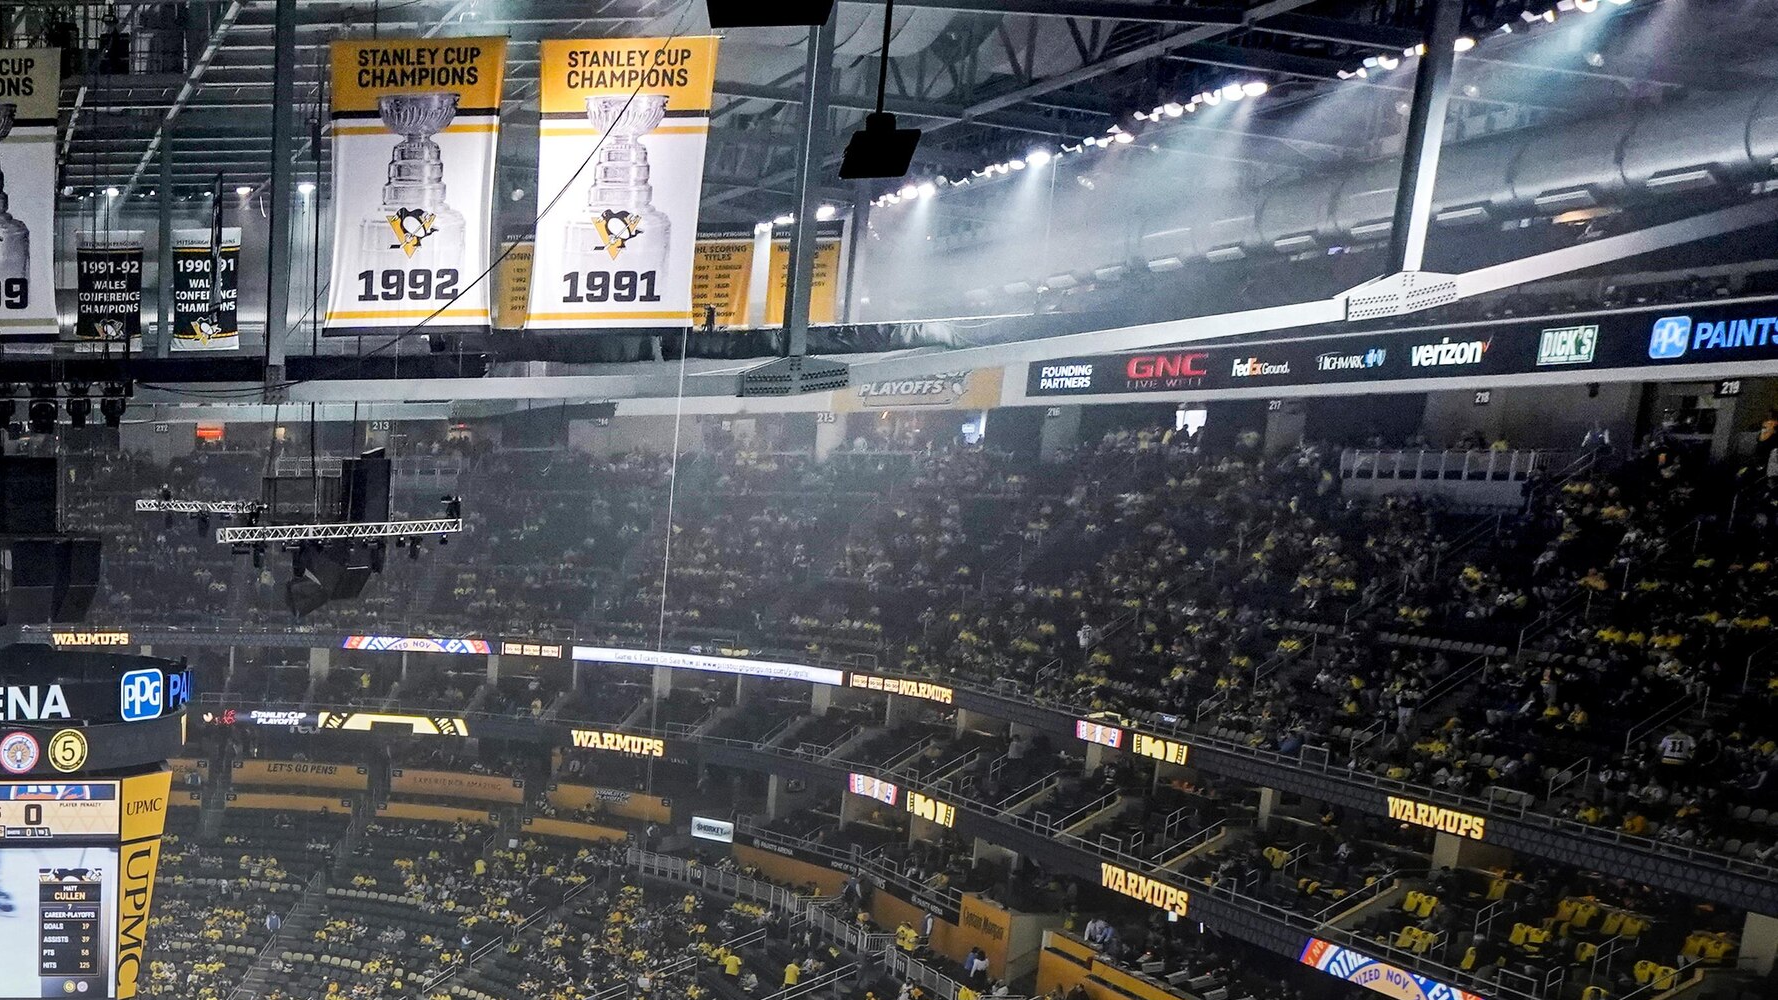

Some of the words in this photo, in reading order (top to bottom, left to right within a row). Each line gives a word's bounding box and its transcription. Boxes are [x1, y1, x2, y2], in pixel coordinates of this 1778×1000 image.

[0, 58, 34, 76] CUP
[358, 49, 440, 67] STANLEY
[444, 47, 481, 65] CUP
[568, 50, 651, 68] STANLEY
[655, 49, 691, 66] CUP
[358, 67, 478, 88] CHAMPIONS
[567, 68, 688, 89] CHAMPIONS
[81, 260, 139, 274] 1991-92
[93, 280, 126, 290] WALES
[358, 268, 459, 302] 1992
[563, 270, 660, 303] 1991
[79, 291, 140, 302] CONFERENCE
[80, 303, 138, 313] CHAMPIONS
[1541, 327, 1593, 358] DICK'S
[1652, 321, 1689, 354] PPG
[1411, 337, 1483, 367] verizon
[1041, 364, 1093, 378] FOUNDING
[1126, 353, 1207, 379] GNC
[1232, 357, 1263, 377] FedEx
[858, 380, 945, 397] PLAYOFFS
[1040, 377, 1091, 390] PARTNERS
[1721, 381, 1740, 395] 219
[52, 633, 129, 646] WARMUPS
[124, 674, 161, 715] PPG
[899, 680, 953, 705] WARMUPS
[250, 710, 287, 719] STANLEY
[288, 711, 306, 720] CUP
[257, 718, 299, 726] PLAYOFFS
[61, 739, 76, 762] 5
[570, 729, 664, 757] WARMUPS
[267, 763, 292, 773] LET'S
[295, 764, 308, 773] GO
[309, 764, 338, 775] PENS!
[126, 797, 163, 817] UPMC
[1387, 795, 1486, 841] WARMUPS
[689, 868, 702, 880] 110
[54, 892, 86, 900] CULLEN
[1100, 862, 1188, 917] WARMUPS
[118, 848, 151, 987] UPMC
[983, 918, 1004, 941] Morgan
